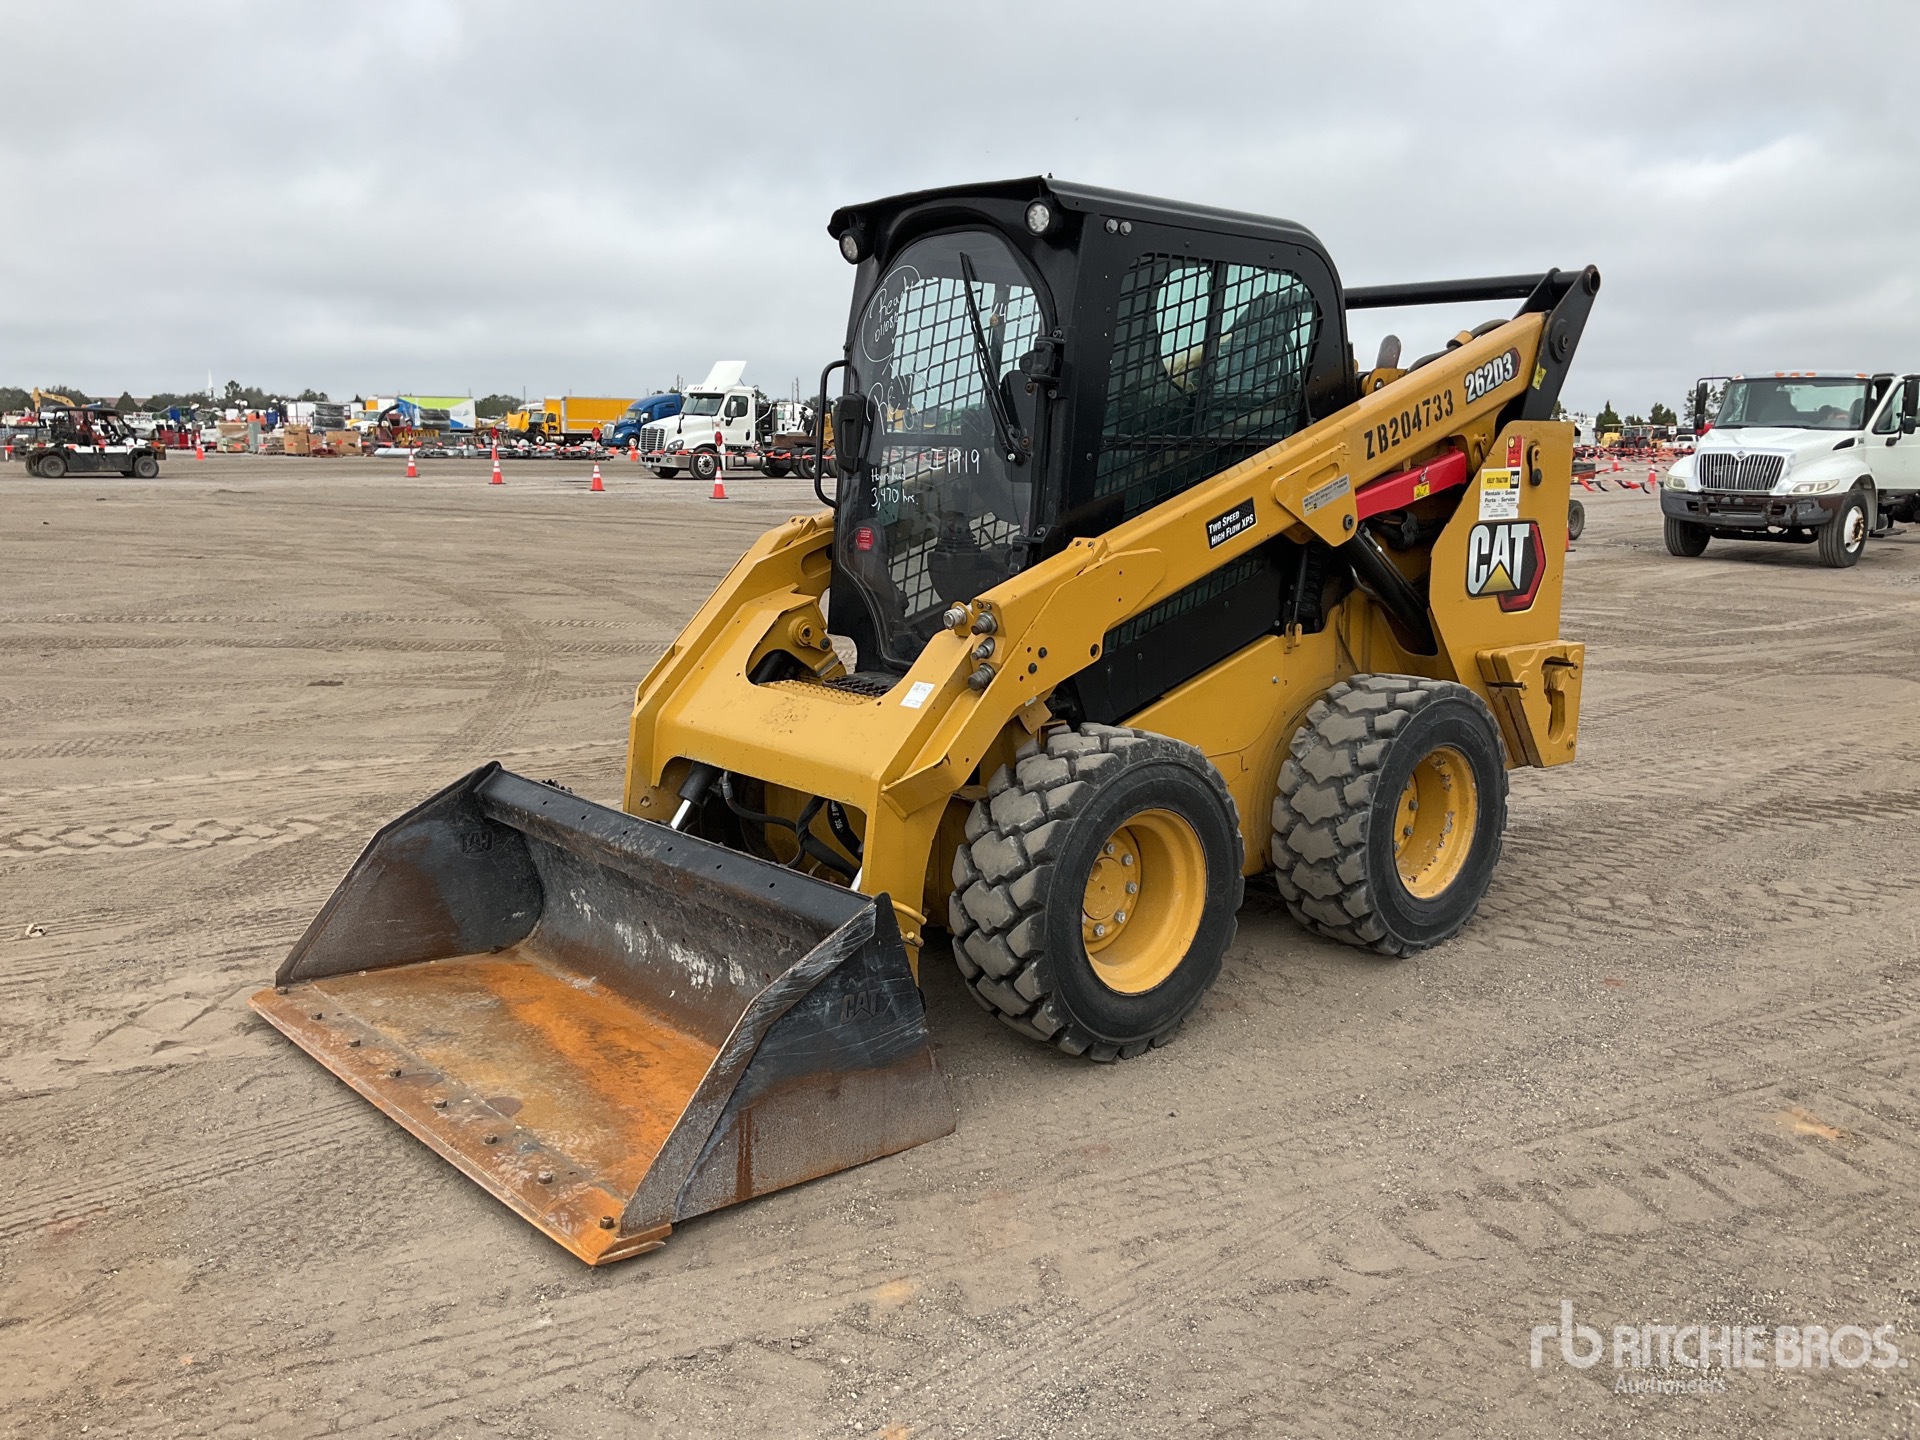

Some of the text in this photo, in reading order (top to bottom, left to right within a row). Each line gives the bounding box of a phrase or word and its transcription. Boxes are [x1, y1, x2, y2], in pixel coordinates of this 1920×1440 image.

[1464, 351, 1514, 403] 262D3
[1363, 389, 1454, 461] ZB204733
[871, 487, 900, 511] 3,470
[1241, 513, 1254, 528] XPS
[1467, 523, 1530, 595] CAT
[841, 989, 882, 1024] CAT
